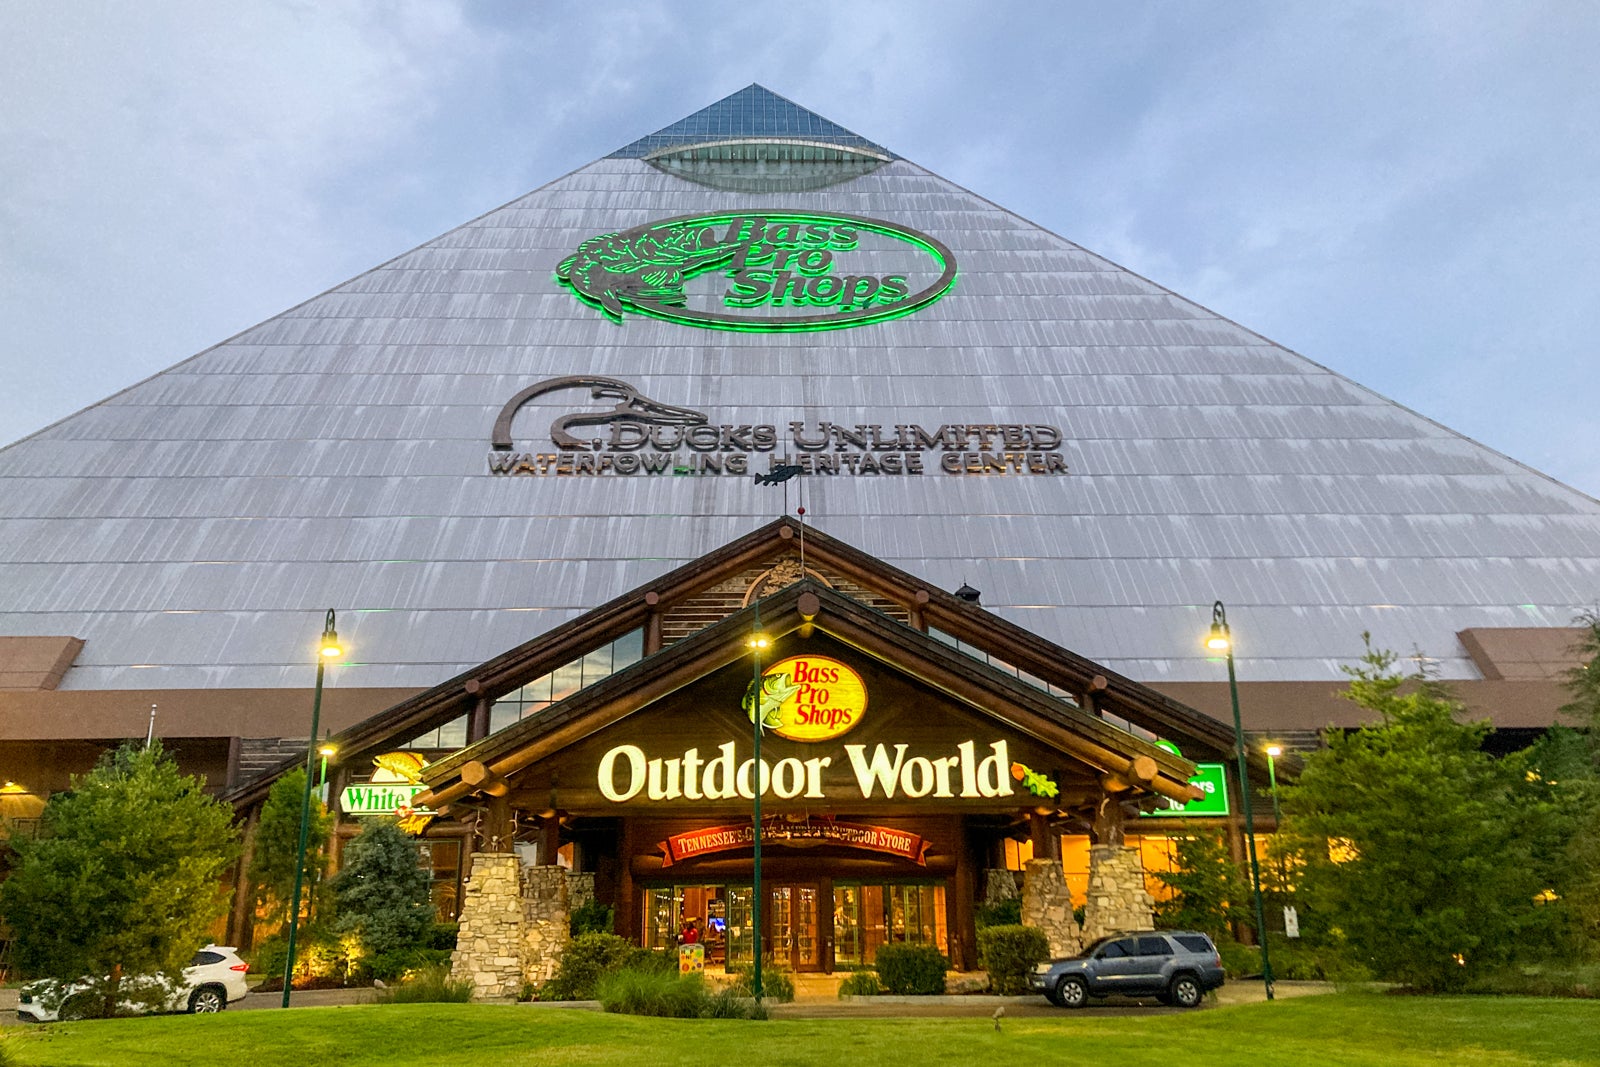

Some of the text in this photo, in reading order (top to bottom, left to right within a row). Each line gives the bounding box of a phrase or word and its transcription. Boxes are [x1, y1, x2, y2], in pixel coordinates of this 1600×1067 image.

[720, 217, 859, 249] Bass
[726, 240, 833, 275] Pro
[725, 269, 910, 308] Shops
[607, 421, 1064, 451] DUCKS UNLIMITED
[487, 452, 1068, 476] WATERFOWLING HERITAGE CENTER
[793, 661, 839, 683] Bass
[794, 683, 829, 704] Pro
[794, 704, 853, 730] Shops
[598, 740, 1015, 802] Outdoor World
[346, 787, 405, 811] White
[677, 829, 743, 854] TENNESSEE'S
[878, 831, 912, 852] STORE
